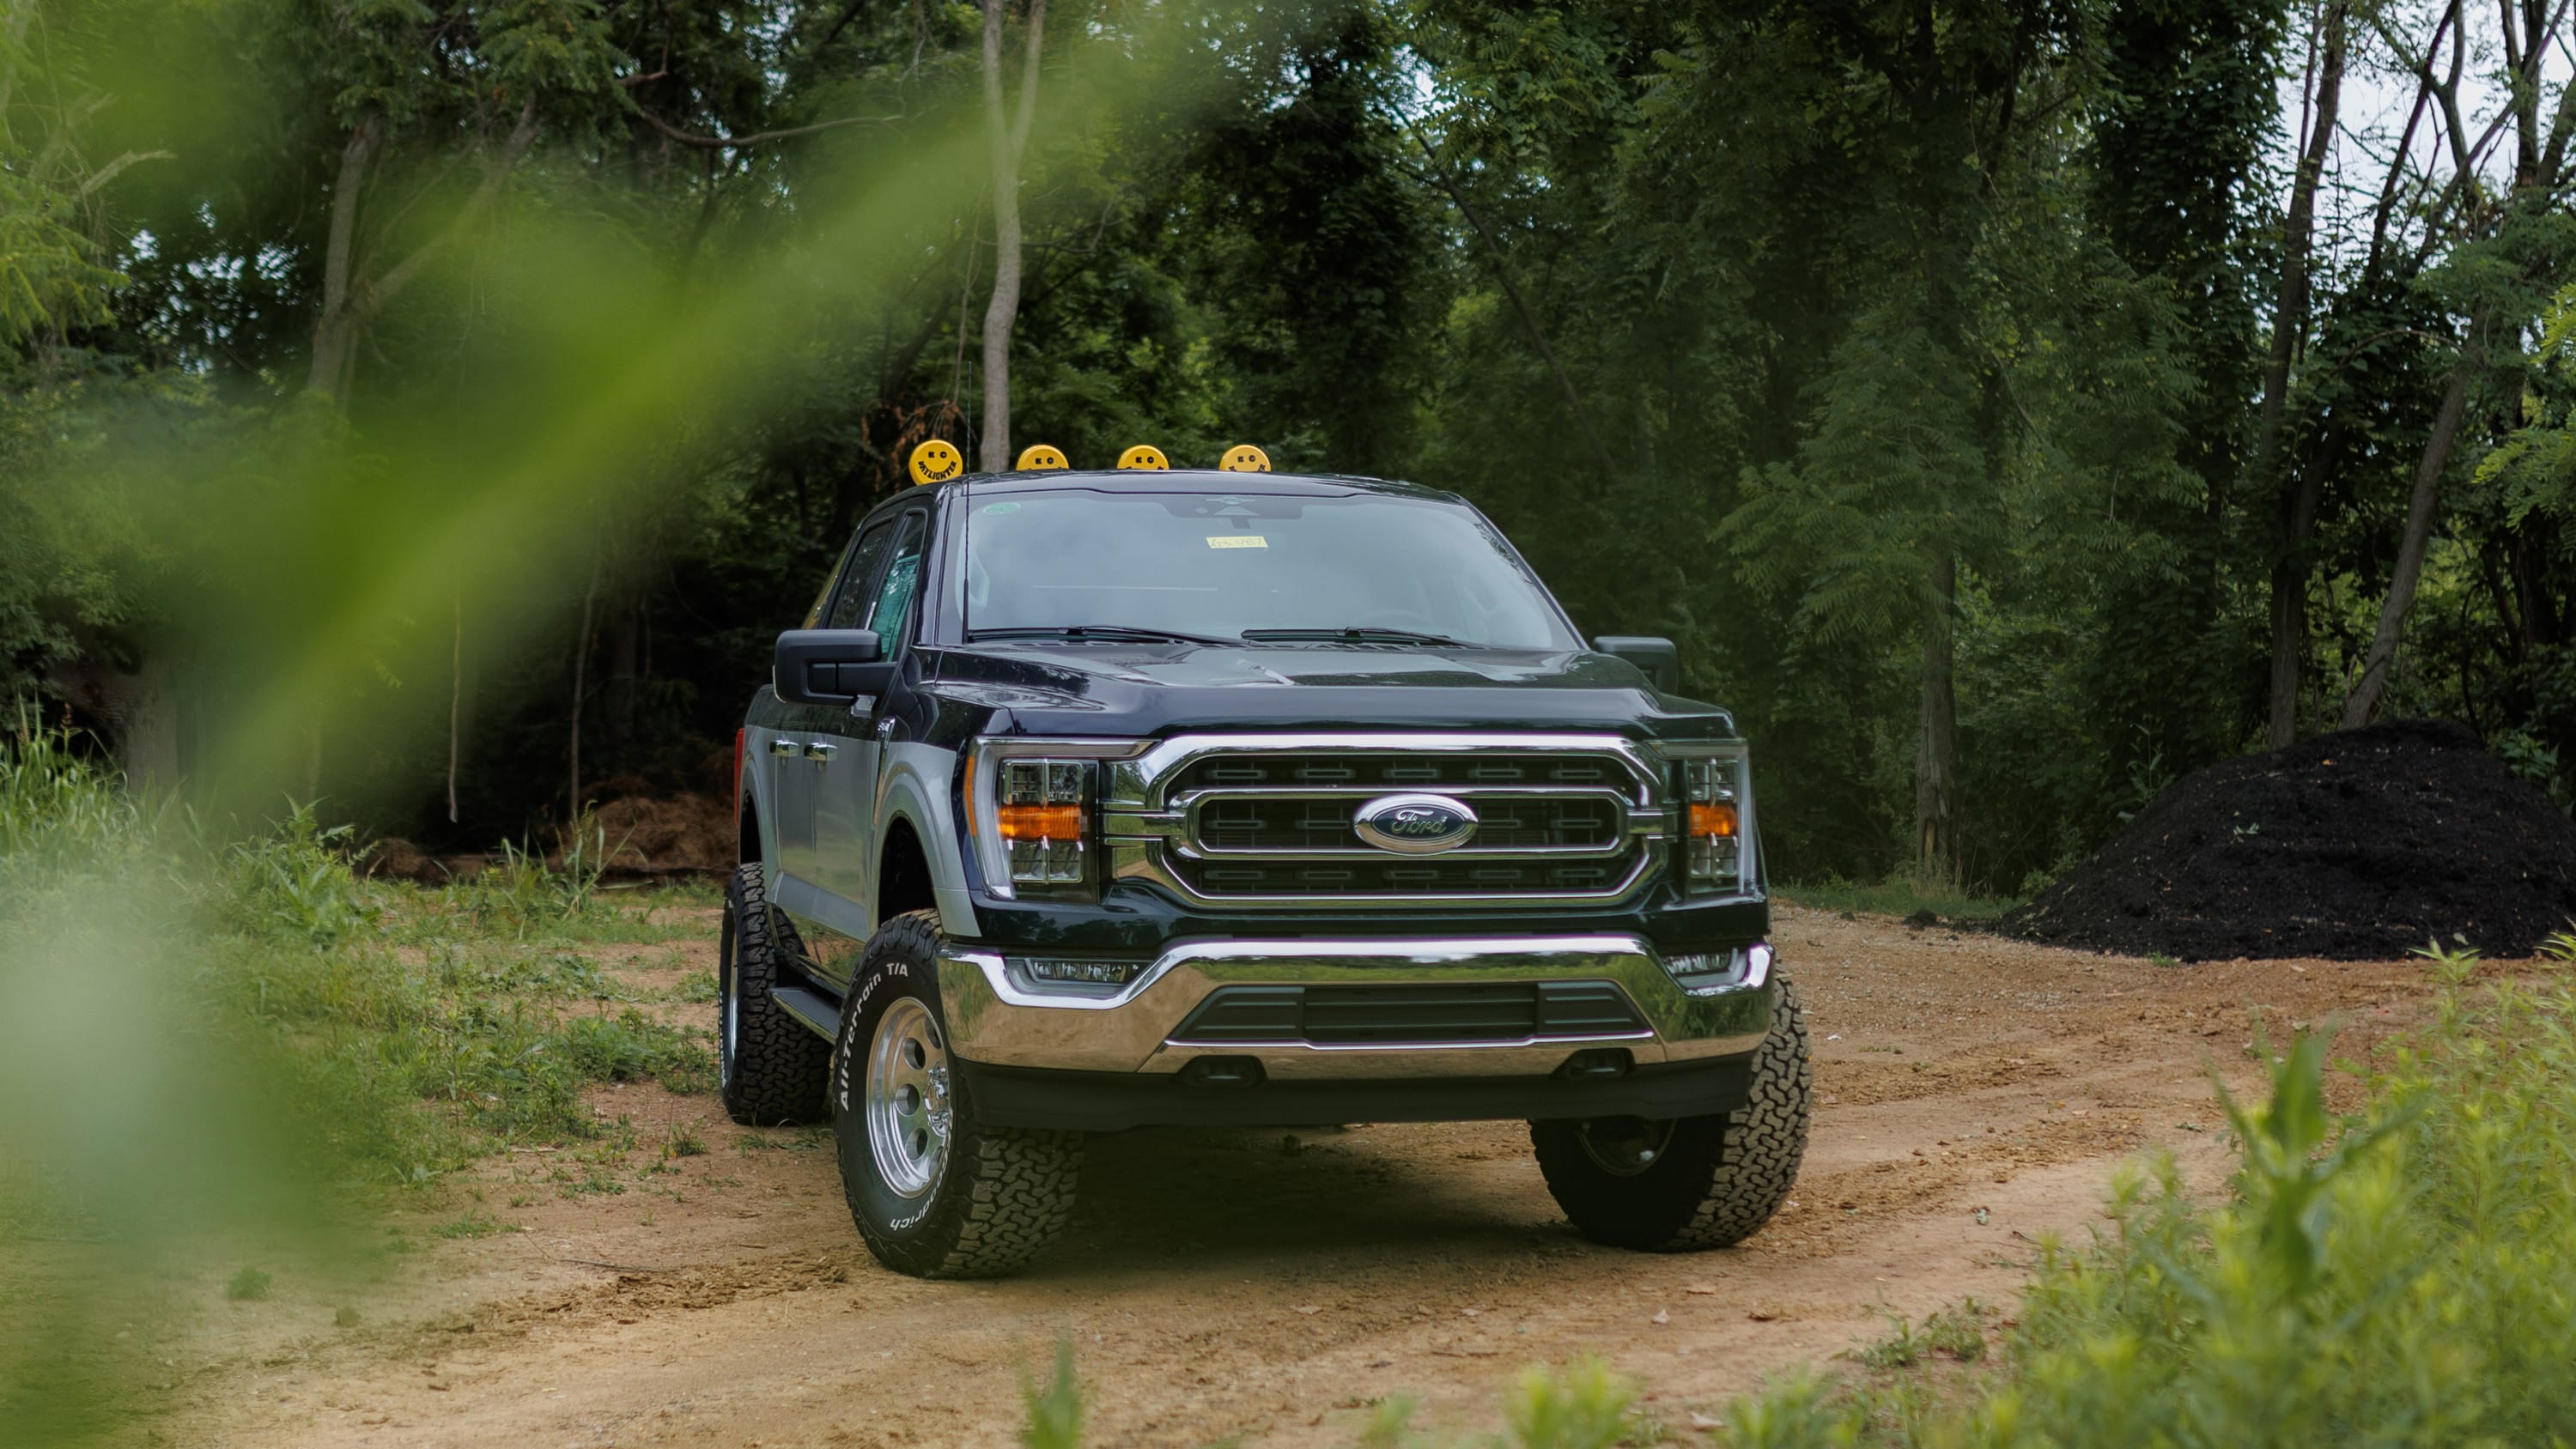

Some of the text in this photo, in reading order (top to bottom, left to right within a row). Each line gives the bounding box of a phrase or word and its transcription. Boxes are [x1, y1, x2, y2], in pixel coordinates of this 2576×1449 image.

[917, 460, 957, 481] DAYLIGHTER
[1390, 808, 1449, 834] Ford
[841, 961, 909, 1112] All-Terrain T/A
